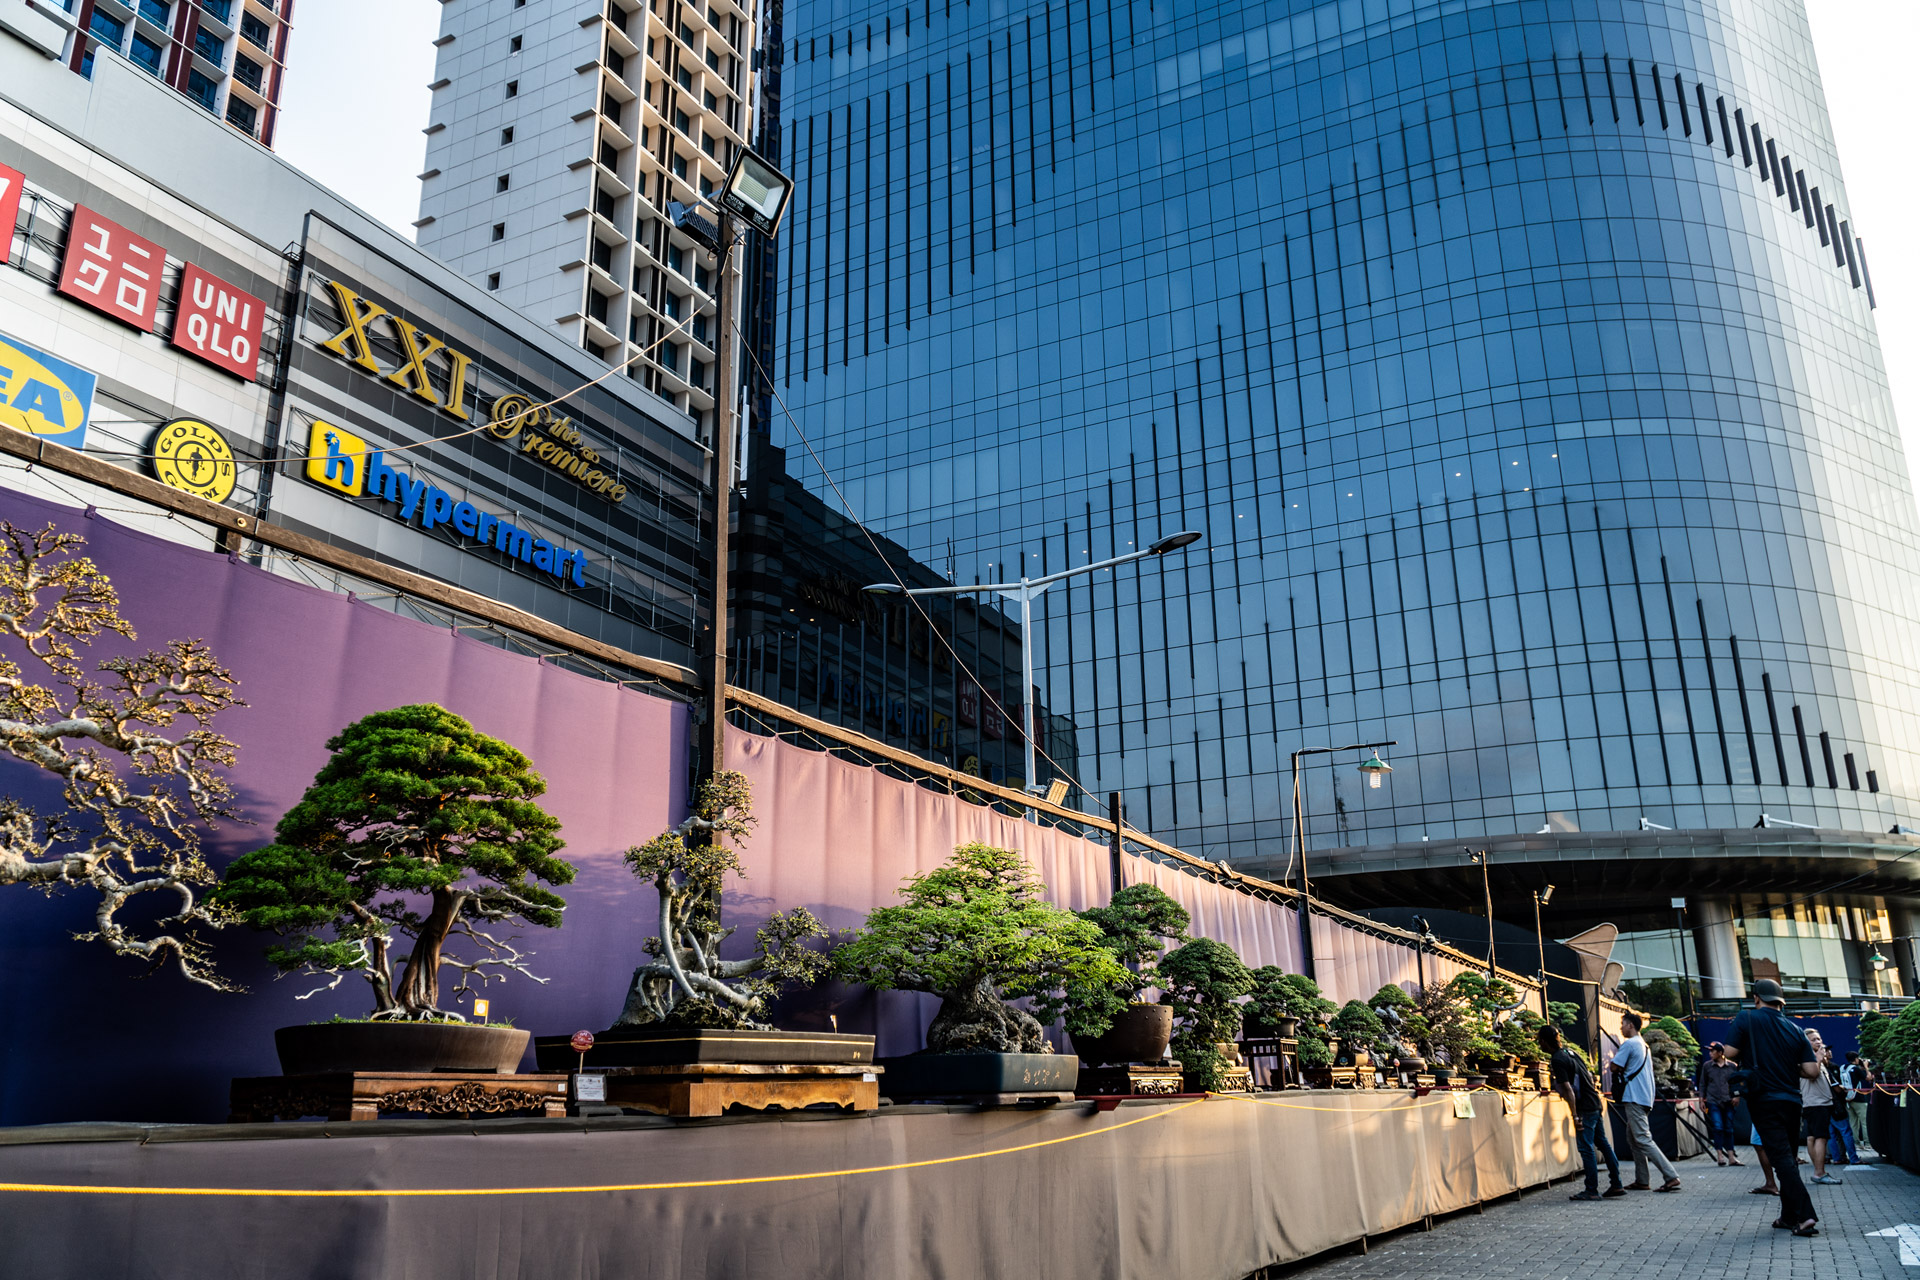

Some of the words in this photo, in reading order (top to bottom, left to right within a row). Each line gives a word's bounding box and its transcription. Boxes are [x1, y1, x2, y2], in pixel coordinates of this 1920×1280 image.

[193, 277, 251, 331] UNI
[187, 313, 250, 364] QLO
[320, 280, 473, 421] XXI
[160, 425, 231, 477] GOLD'S
[367, 447, 589, 588] hypermart
